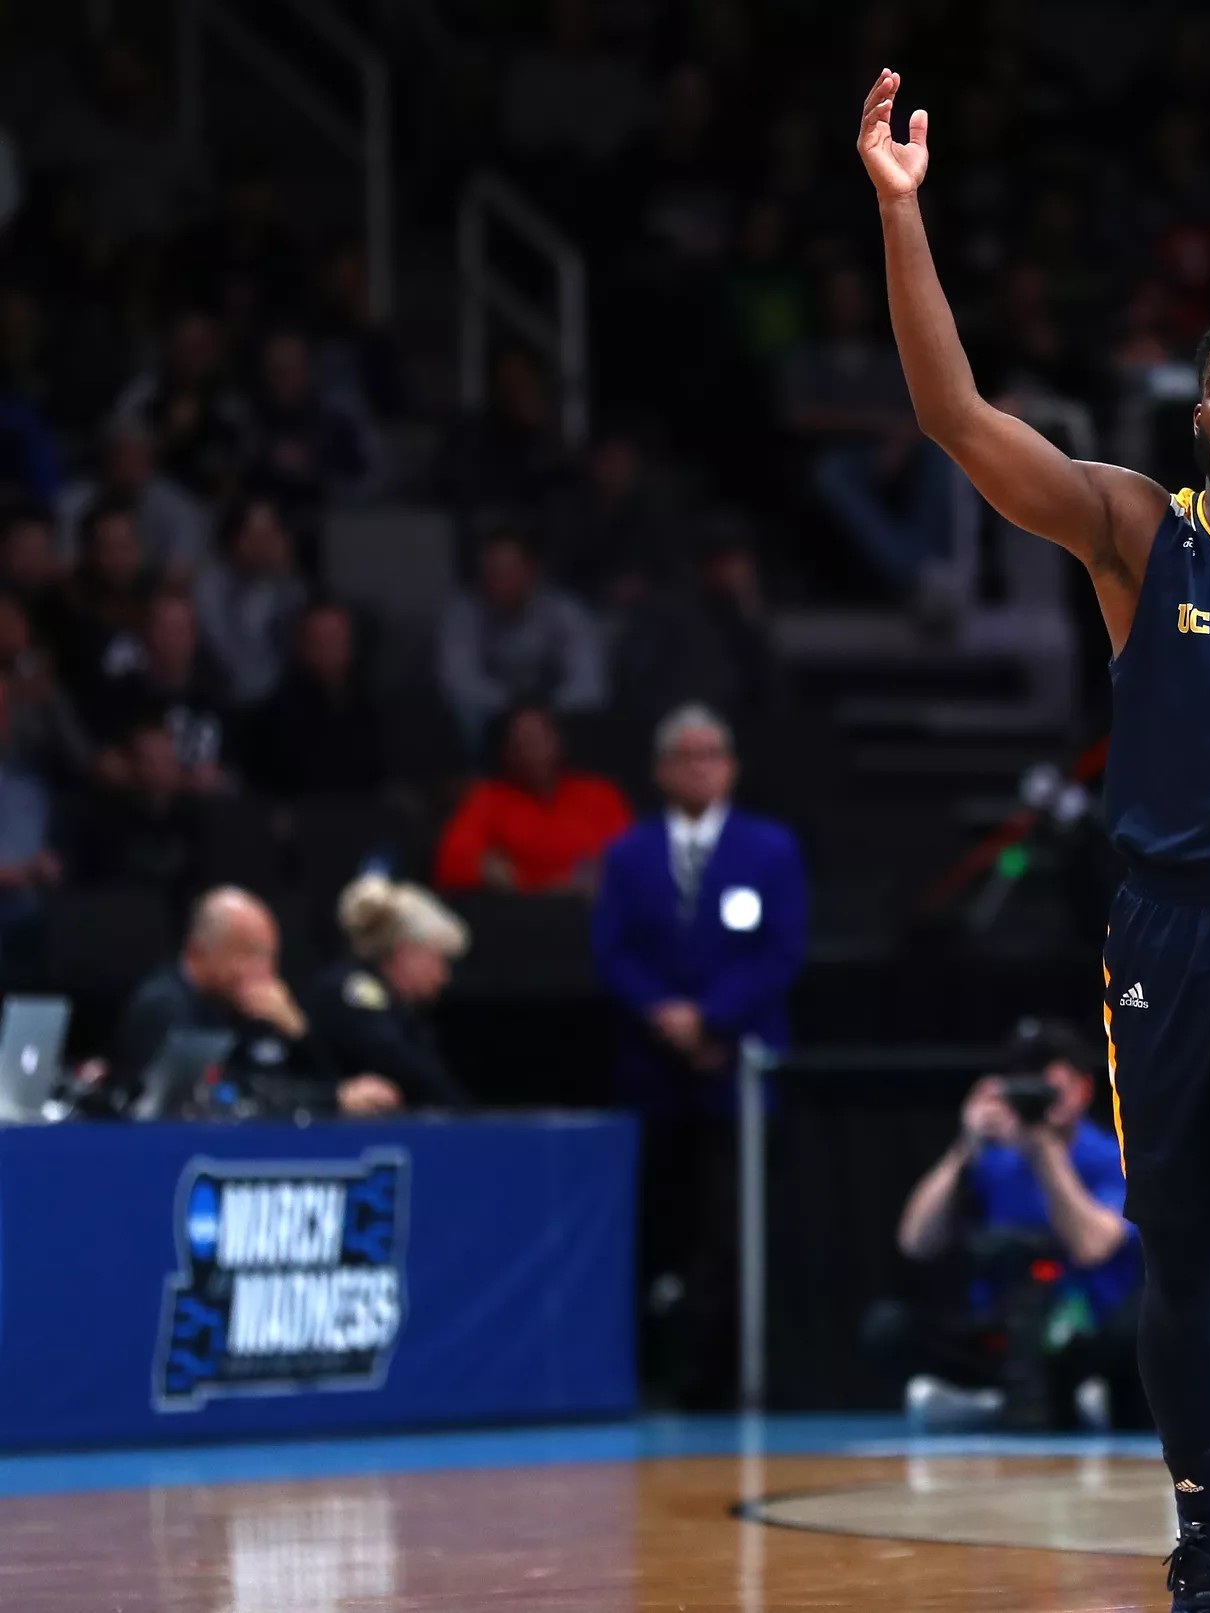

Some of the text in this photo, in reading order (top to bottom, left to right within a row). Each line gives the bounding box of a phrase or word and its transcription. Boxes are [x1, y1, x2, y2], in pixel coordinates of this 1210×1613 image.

[1177, 603, 1210, 635] UC
[1120, 998, 1149, 1009] adidas
[216, 1180, 348, 1269] MARCH
[226, 1267, 400, 1355] MADNESS
